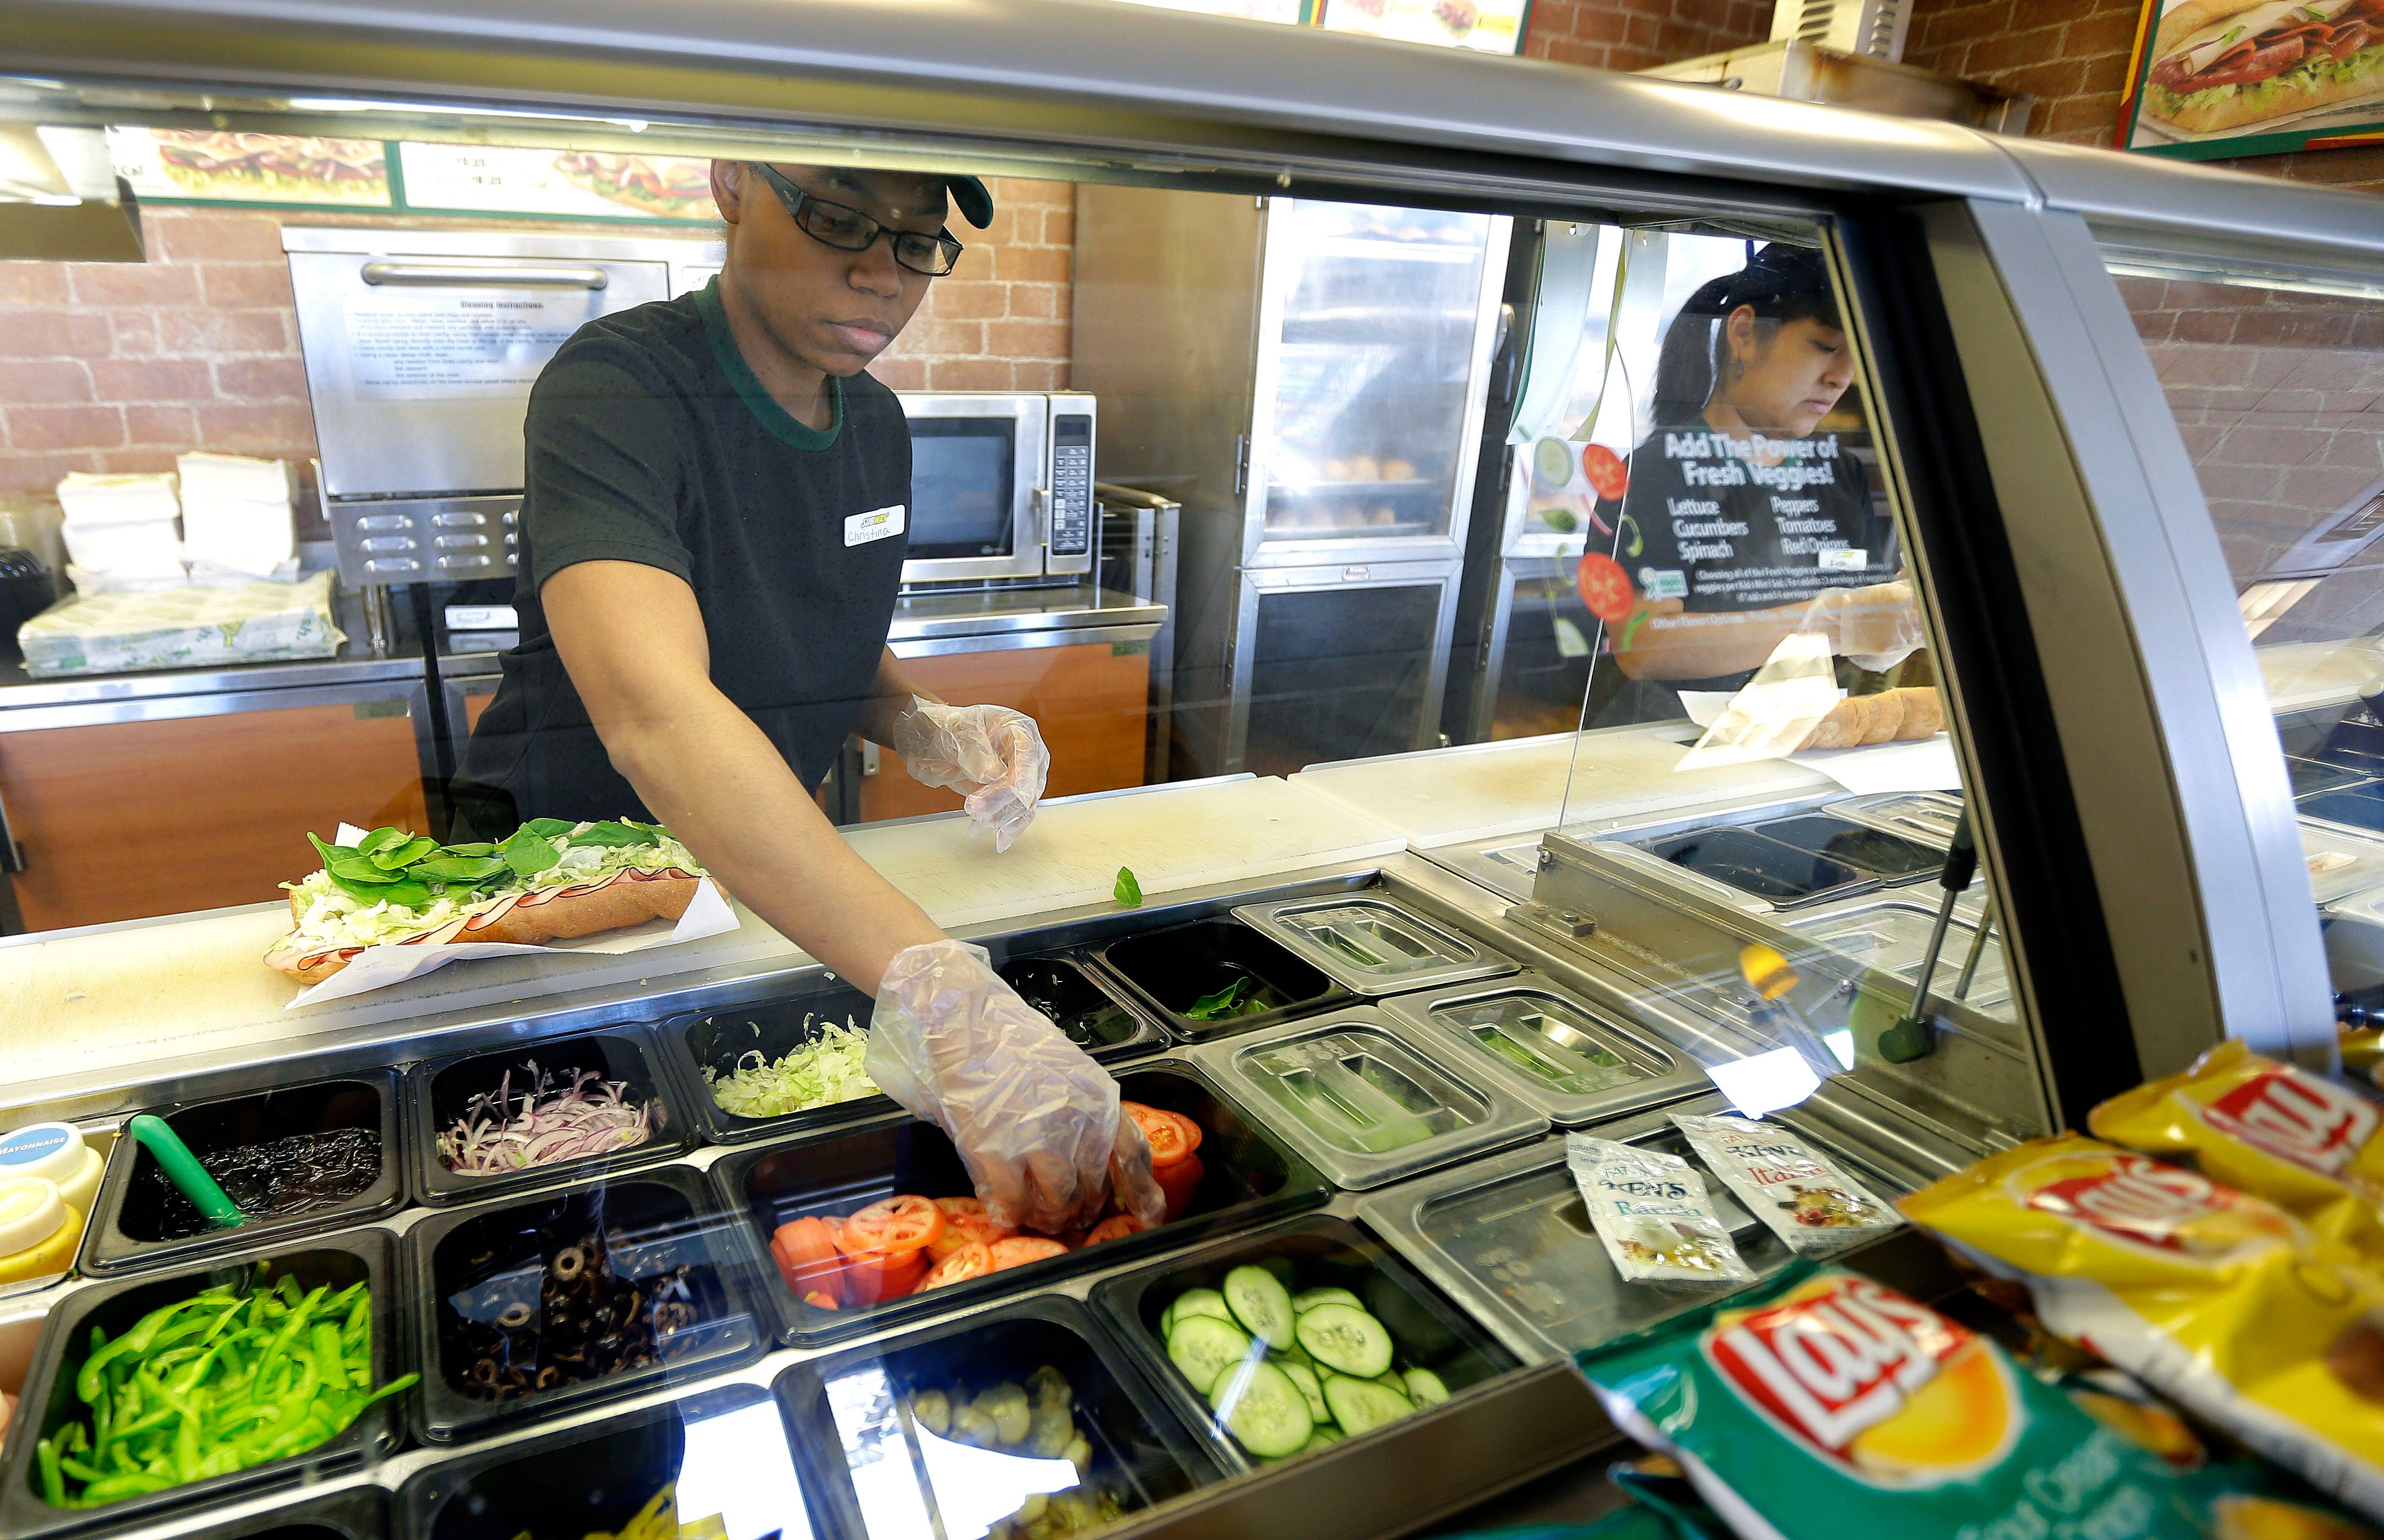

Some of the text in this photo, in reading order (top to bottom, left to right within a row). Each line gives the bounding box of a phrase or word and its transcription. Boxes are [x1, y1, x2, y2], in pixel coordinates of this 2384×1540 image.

[1664, 432, 1839, 459] Add The Power of
[1682, 460, 1835, 492] Fresh Veggies!
[1666, 497, 1721, 517] Lettuce
[1769, 496, 1819, 517] Peppers
[860, 512, 890, 529] SUBWAY
[1671, 517, 1749, 538] Cucumbers
[1773, 517, 1837, 535] Tomatoes
[848, 528, 891, 542] Christina
[1677, 538, 1735, 565] Spinach
[1779, 537, 1808, 556] Red
[1696, 570, 1734, 581] Choosing
[0, 1136, 66, 1155] MAYONNAISE
[1722, 1284, 1955, 1450] Lay's
